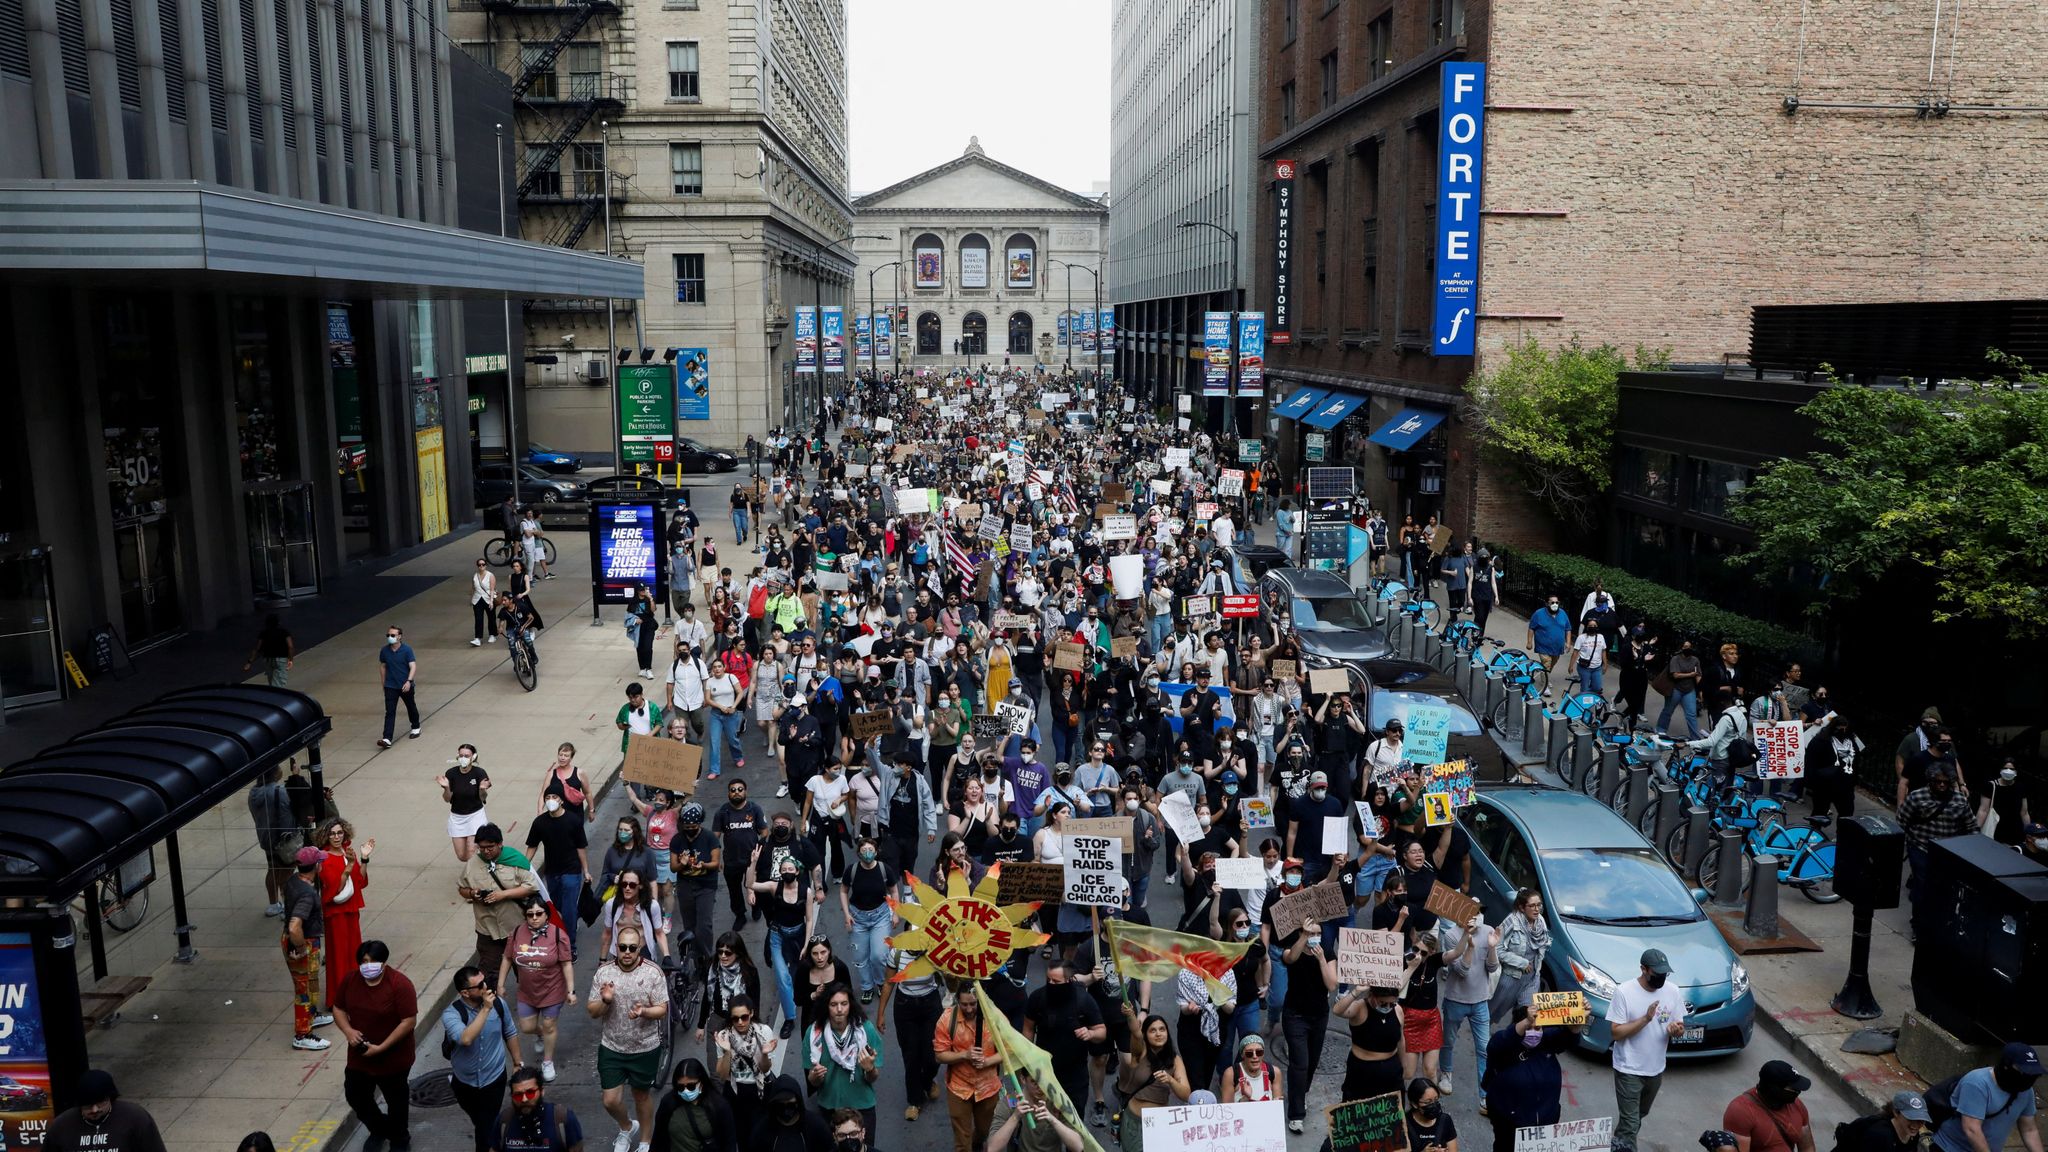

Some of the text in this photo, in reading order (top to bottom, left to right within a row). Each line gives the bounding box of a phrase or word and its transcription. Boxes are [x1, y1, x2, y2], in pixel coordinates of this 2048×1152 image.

[1447, 73, 1476, 260] FORTE
[1278, 187, 1288, 269] SYMPHONY
[1277, 274, 1286, 325] STORE
[123, 455, 149, 488] 50
[1220, 478, 1241, 487] FUCK
[1223, 487, 1237, 495] ICE
[611, 527, 644, 540] HERE,
[615, 539, 645, 548] EVERY
[607, 548, 651, 557] STREET IS
[611, 557, 648, 568] RUSH
[606, 568, 647, 578] STREET
[997, 704, 1026, 719] SHOW
[974, 715, 1004, 724] SHOW
[1413, 729, 1440, 737] IGNORANCE
[1787, 726, 1799, 750] STOP
[1756, 727, 1768, 779] IS PATRIOTISM
[1766, 727, 1777, 773] UR RACISM
[1775, 727, 1788, 777] PRETENDING
[1433, 759, 1467, 777] SHOW
[1427, 775, 1473, 794] UP FOR
[1065, 820, 1125, 832] THIS SHIT
[1073, 838, 1111, 848] STOP
[1078, 849, 1107, 860] THE
[1072, 859, 1114, 871] RAIDS
[1080, 874, 1106, 885] ICE
[1071, 884, 1116, 894] OUT OF
[1066, 892, 1121, 905] CHICAGO
[1430, 887, 1458, 917] FUCK
[924, 900, 1012, 950] LET THE IN
[1346, 931, 1396, 947] NO ONE IS
[1359, 944, 1396, 956] ILLEGAL
[1341, 953, 1353, 964] ON
[1354, 954, 1384, 965] STOLEN
[1340, 967, 1362, 978] NADIE
[1537, 991, 1578, 1003] NO ONE IS
[1536, 1000, 1578, 1011] ILLEGAL ON
[1538, 1008, 1570, 1019] STOLEN
[1562, 1015, 1584, 1024] LAND
[1168, 1107, 1192, 1125] It
[18, 1120, 48, 1131] JULY
[1517, 1118, 1612, 1141] THE POWER OF
[1182, 1119, 1244, 1145] NEVER
[80, 1133, 108, 1146] NO ONE
